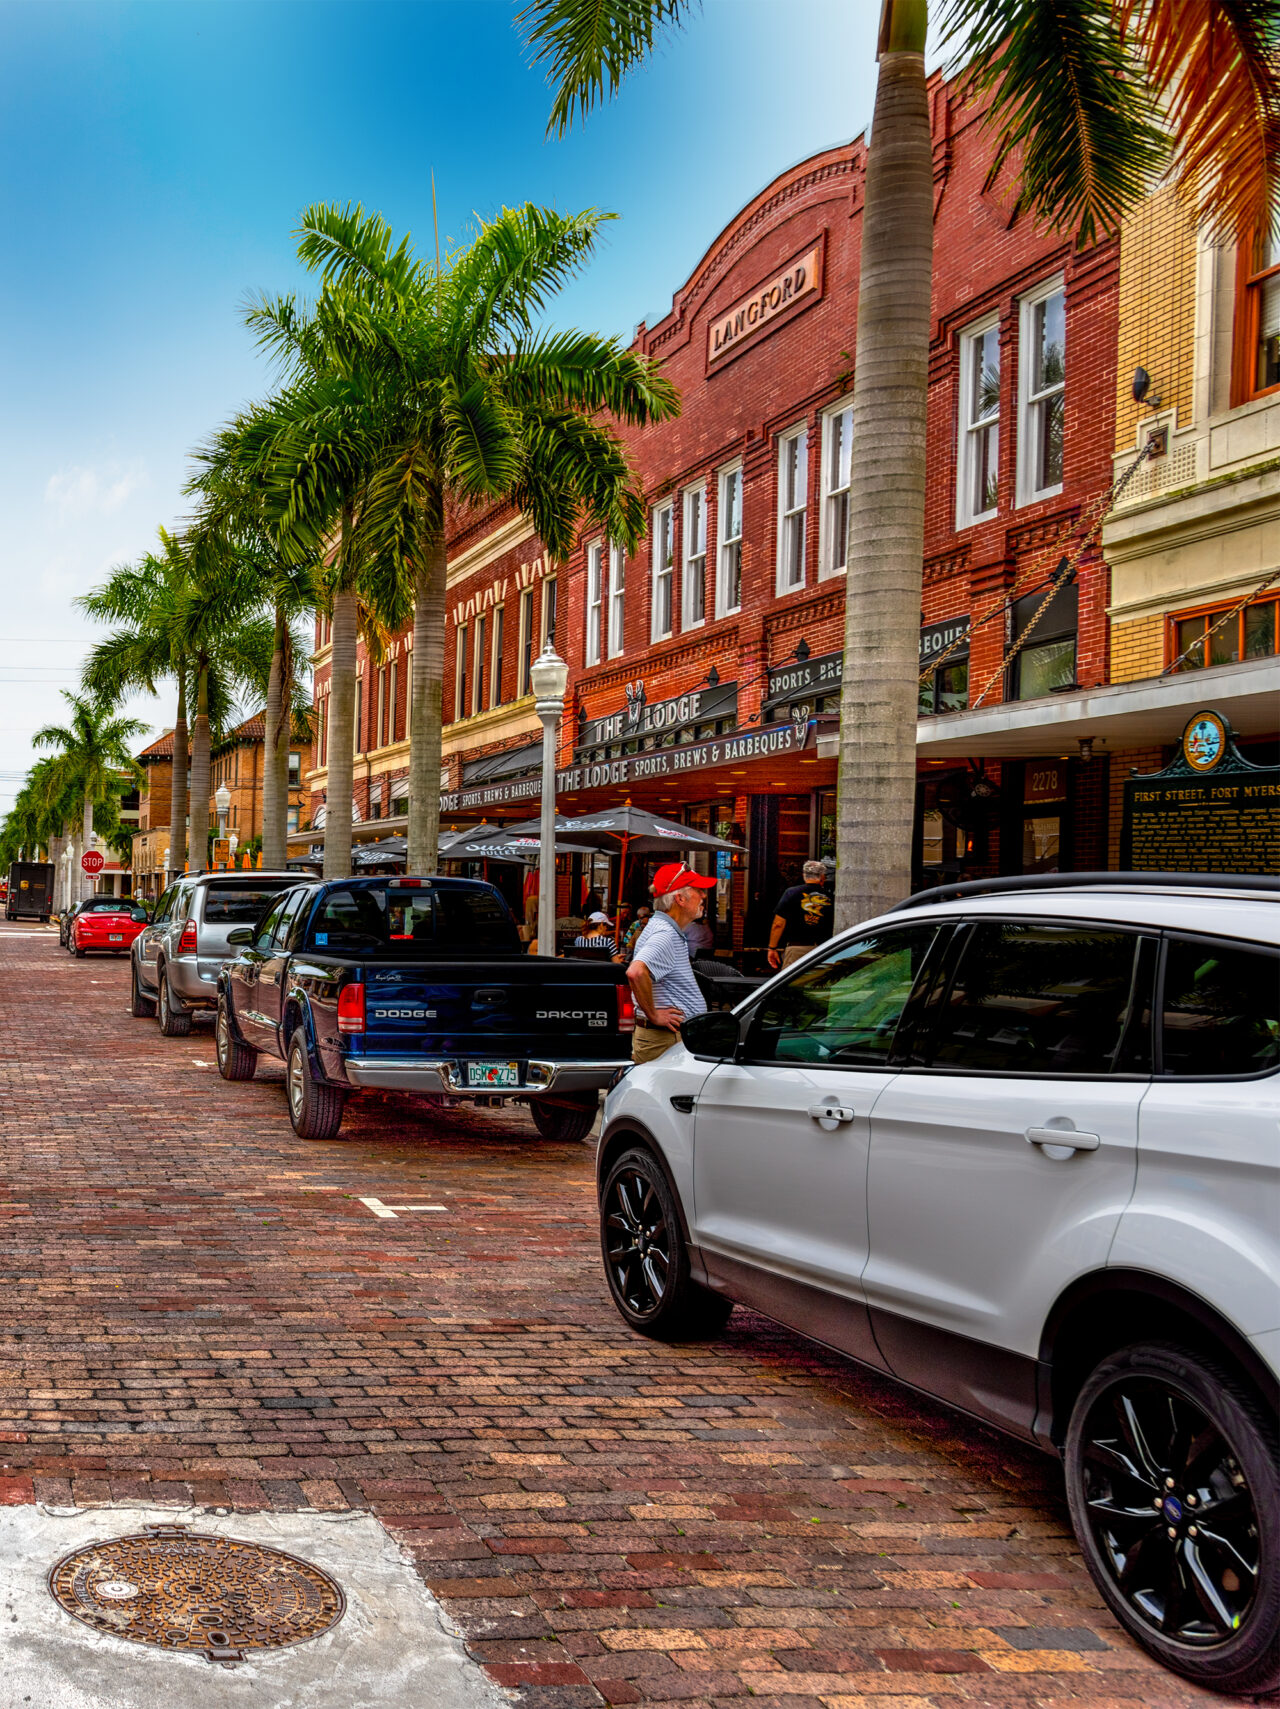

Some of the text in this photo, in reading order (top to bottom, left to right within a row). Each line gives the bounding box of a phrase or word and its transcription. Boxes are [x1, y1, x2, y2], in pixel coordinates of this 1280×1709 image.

[713, 266, 807, 352] LANGFORD
[918, 623, 971, 655] EQUES
[769, 659, 843, 693] SPORTS, BRE
[594, 693, 702, 742] THE LODGE
[557, 729, 792, 792] THE LODGE SPORTS, BREWS & BARBEQUES
[462, 792, 483, 807] SPORTS,
[484, 787, 503, 803] BREWS
[504, 786, 510, 799] &
[511, 780, 542, 799] BARBEQUE
[1032, 770, 1059, 792] 2278
[1134, 791, 1162, 802] FIRST
[1211, 787, 1240, 799] FORT
[1244, 785, 1280, 797] MYERS
[82, 857, 103, 867] STOP
[375, 1009, 608, 1019] DODGE DAKOTA
